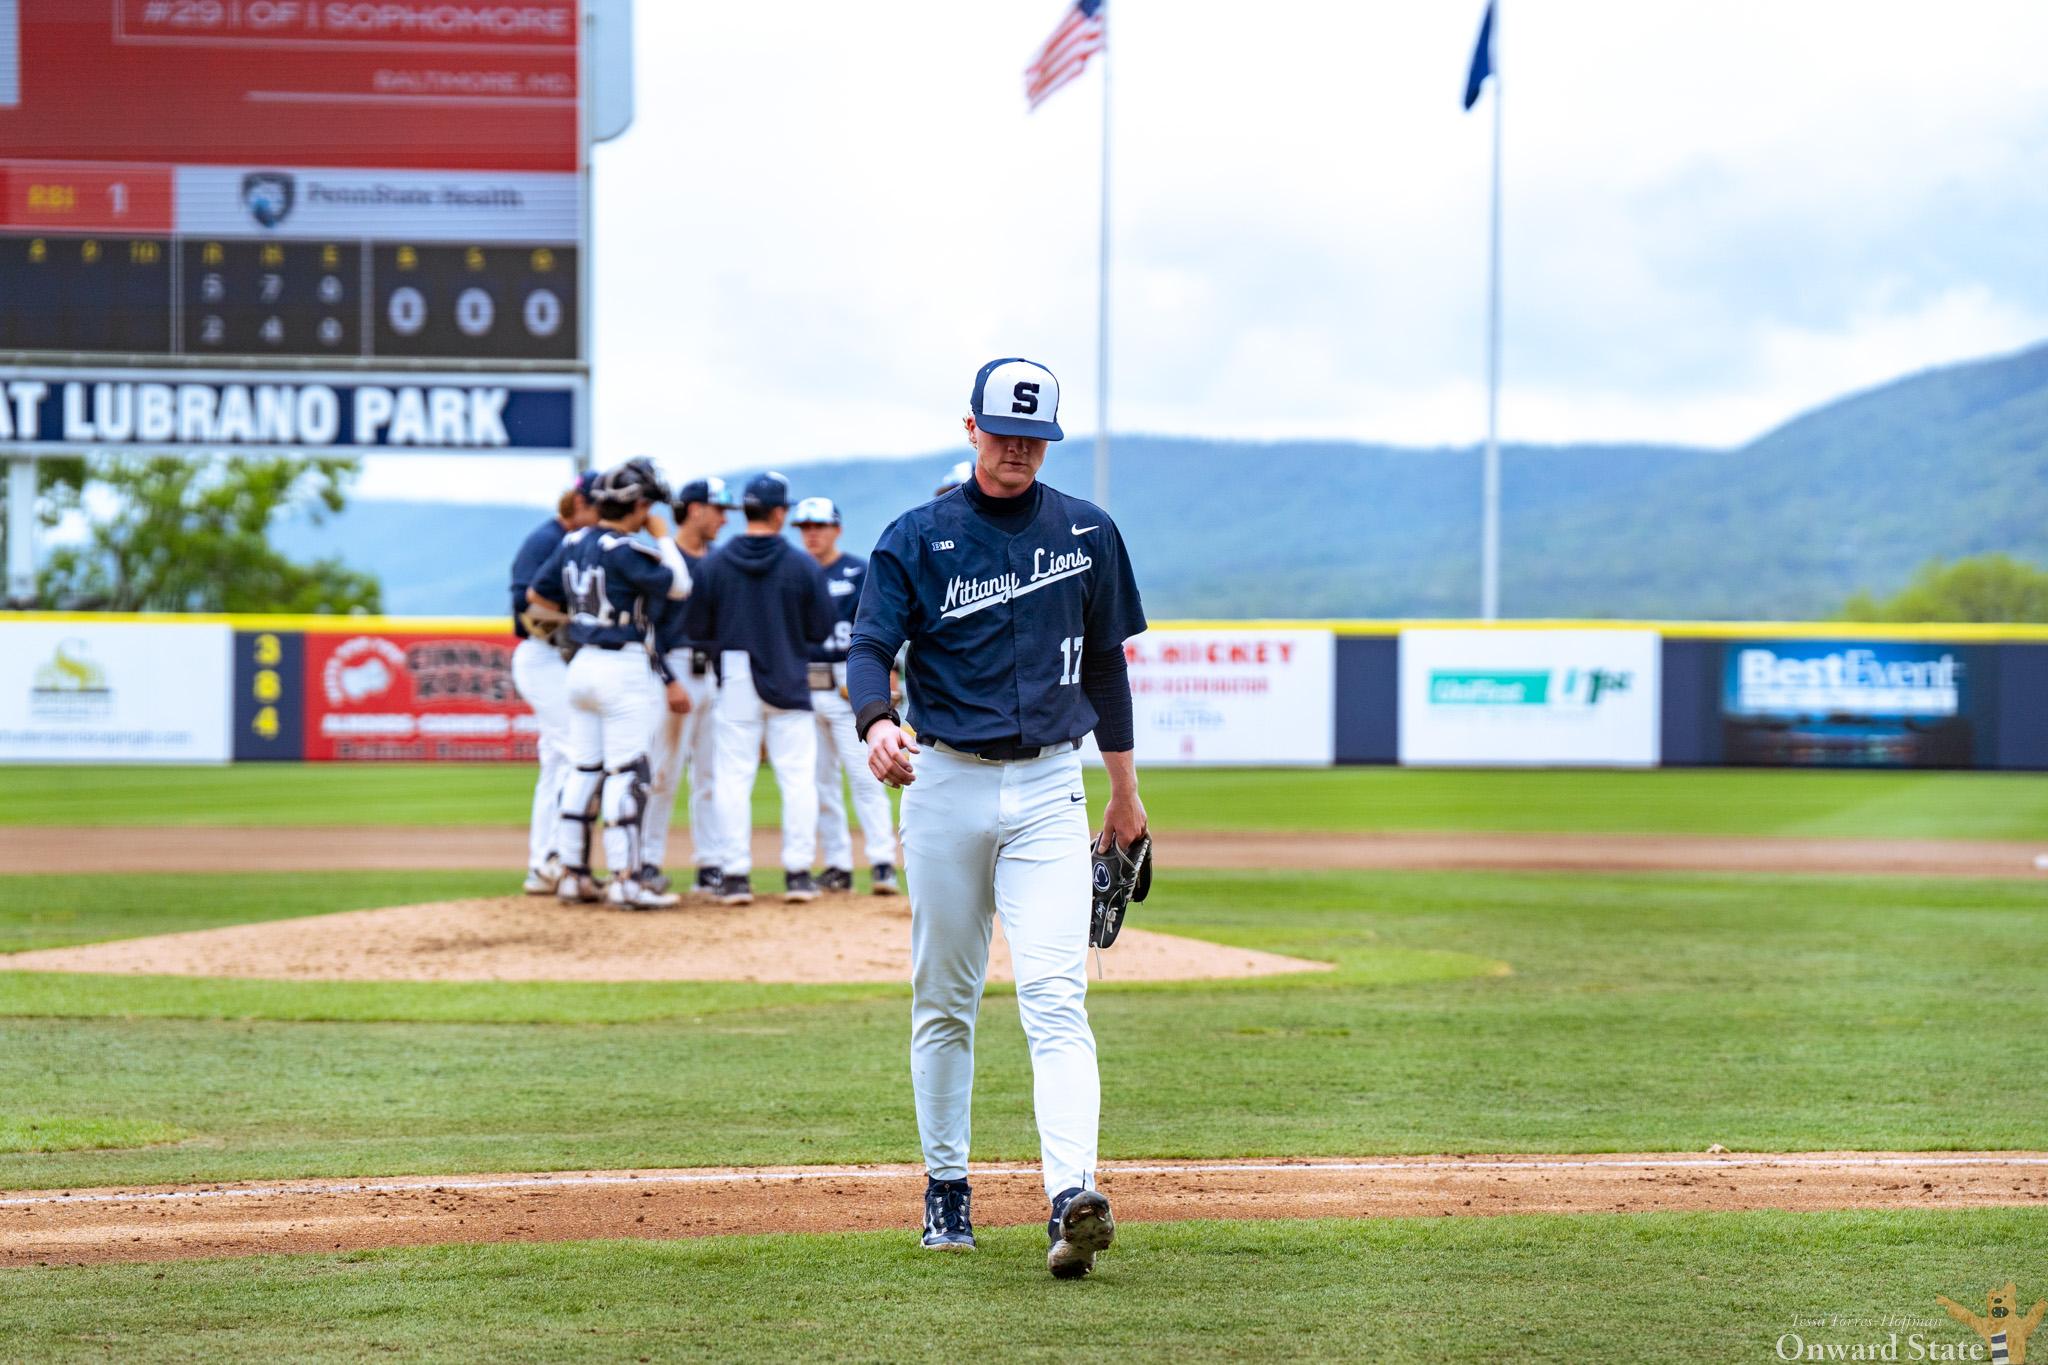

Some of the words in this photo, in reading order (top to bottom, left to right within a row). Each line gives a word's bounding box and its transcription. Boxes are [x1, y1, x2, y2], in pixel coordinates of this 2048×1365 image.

[324, 3, 569, 34] SOPHOMORE
[388, 286, 427, 337] 0
[455, 287, 495, 338] 0
[523, 288, 562, 339] 0
[63, 383, 338, 441] LUBRANO
[354, 386, 510, 447] PARK
[1012, 381, 1040, 414] S
[940, 572, 1020, 612] Nittany
[1030, 547, 1092, 582] Lions
[1059, 636, 1084, 686] 17
